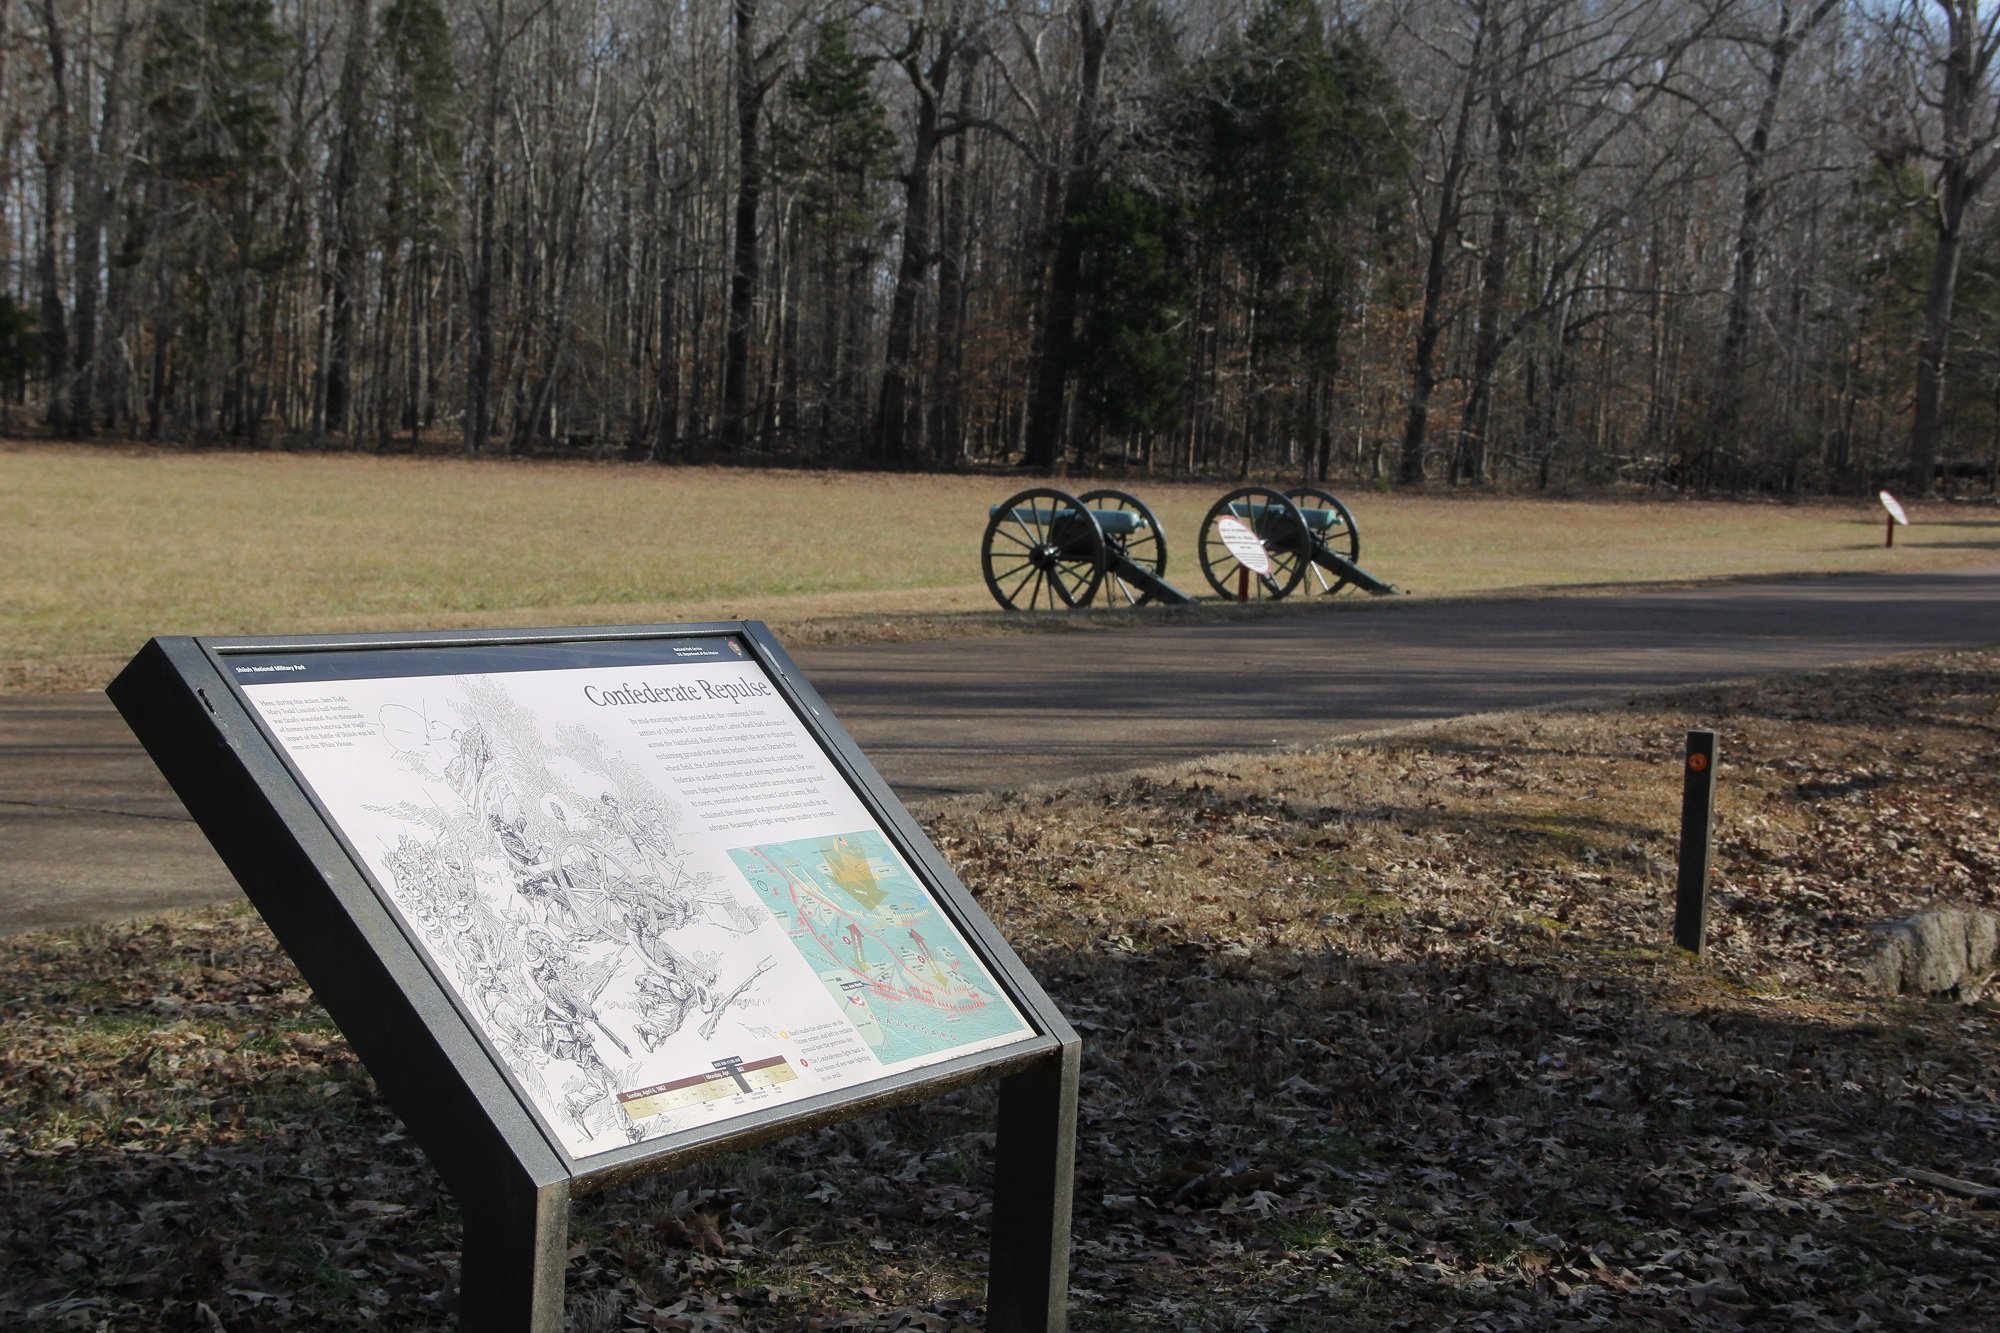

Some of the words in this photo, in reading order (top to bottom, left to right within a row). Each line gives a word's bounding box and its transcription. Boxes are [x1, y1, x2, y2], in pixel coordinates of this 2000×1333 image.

[584, 682, 702, 706] Confederate
[694, 676, 771, 704] Repulse
[765, 804, 784, 812] pressed
[728, 820, 763, 828] Beauregard's
